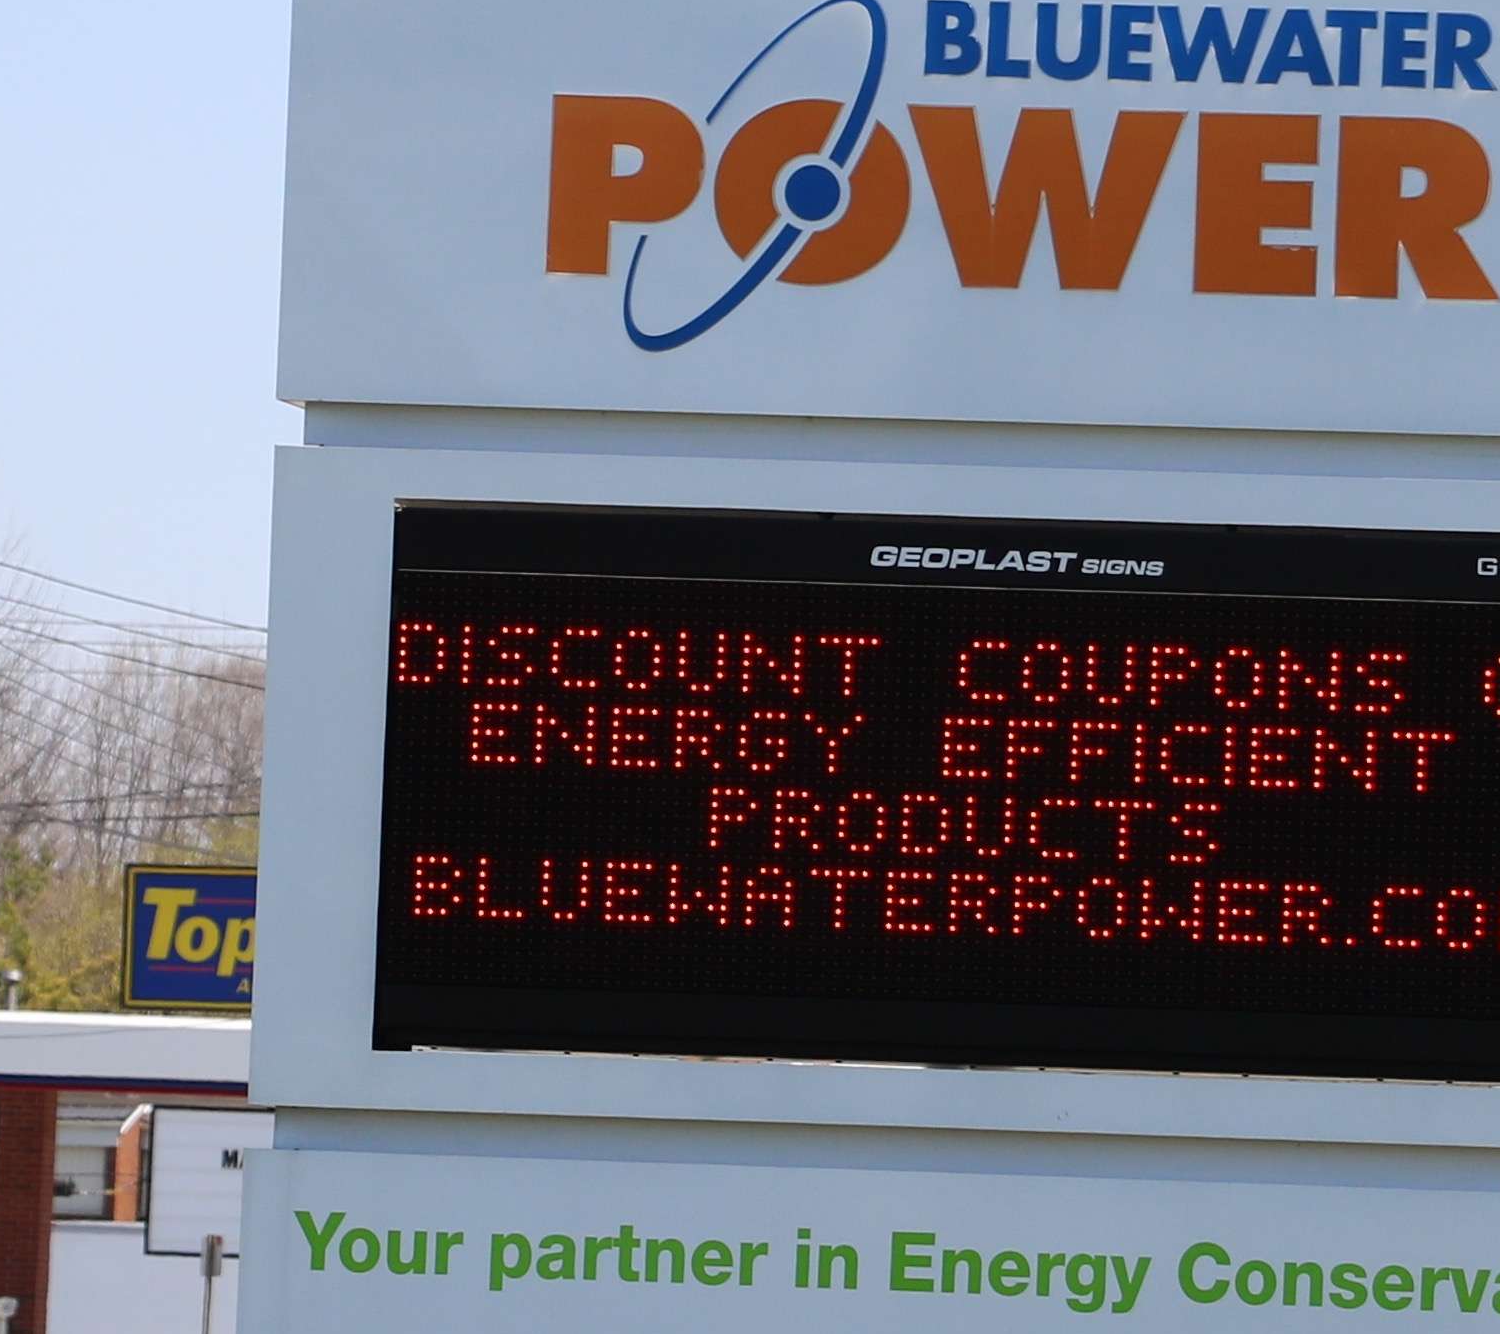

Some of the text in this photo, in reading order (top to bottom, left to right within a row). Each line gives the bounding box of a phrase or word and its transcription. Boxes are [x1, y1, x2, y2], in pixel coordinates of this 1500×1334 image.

[869, 545, 1165, 577] GEOPLAST SIGNS
[397, 622, 881, 695] DISCOUNT
[958, 640, 1405, 712] COUPONS
[470, 702, 1455, 792] ENERGY EFFICIENT
[708, 786, 1221, 863] PRODUCTS
[142, 887, 256, 978] Top
[295, 1210, 465, 1276] Your
[489, 1224, 770, 1293] partner
[794, 1227, 861, 1291] in
[889, 1230, 1153, 1315] Energy
